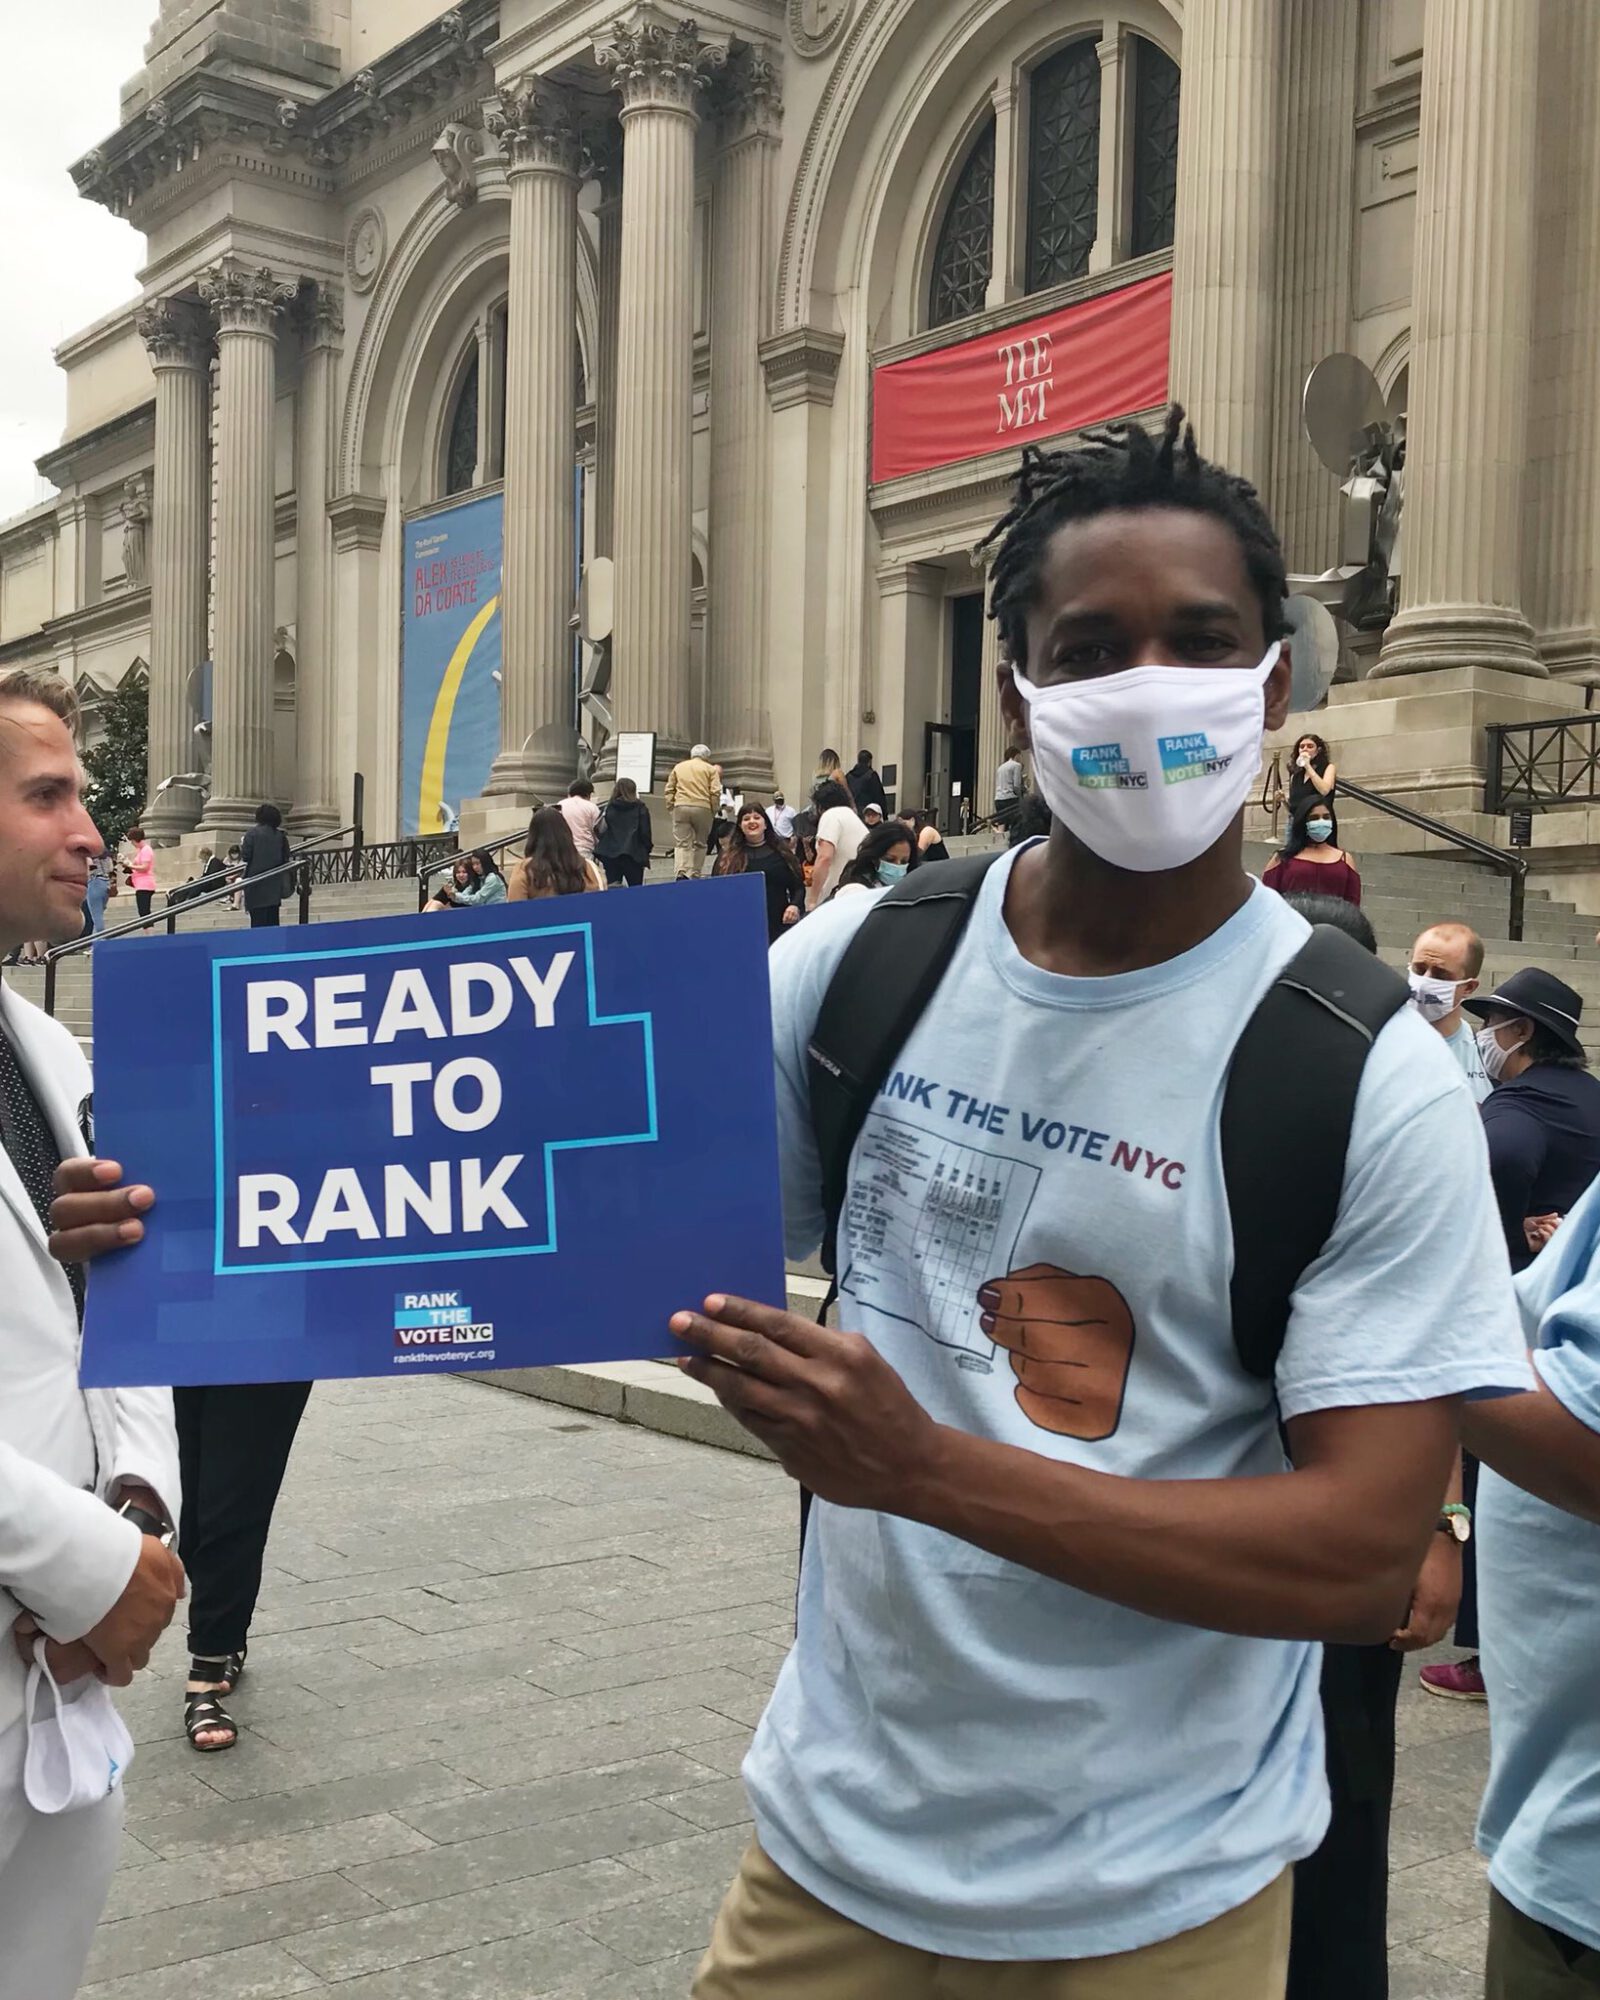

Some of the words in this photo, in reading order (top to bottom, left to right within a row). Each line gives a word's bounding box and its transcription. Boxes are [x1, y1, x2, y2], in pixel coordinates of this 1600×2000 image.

[997, 332, 1053, 387] THE
[995, 378, 1054, 434] MET
[415, 562, 447, 591] ALEX
[415, 592, 432, 617] DA
[436, 579, 477, 611] CORTE
[1080, 746, 1119, 761] RANK
[1165, 736, 1205, 752] RANK
[1184, 747, 1216, 763] THE
[1100, 761, 1127, 774] THE
[1167, 763, 1204, 782] VOTE
[1206, 757, 1232, 772] NYC
[1120, 775, 1145, 786] NYC
[246, 951, 575, 1053] READY
[370, 1057, 502, 1137] TO
[881, 1071, 940, 1109] NK
[946, 1089, 1010, 1135] THE
[1021, 1112, 1110, 1161] VOTE
[1110, 1140, 1186, 1190] NYC
[238, 1154, 528, 1248] RANK
[404, 1292, 458, 1309] RANK
[429, 1309, 468, 1324] THE
[399, 1328, 451, 1344] VOTE
[456, 1326, 491, 1340] NYC
[393, 1350, 496, 1363] rankthevotenyc.org
